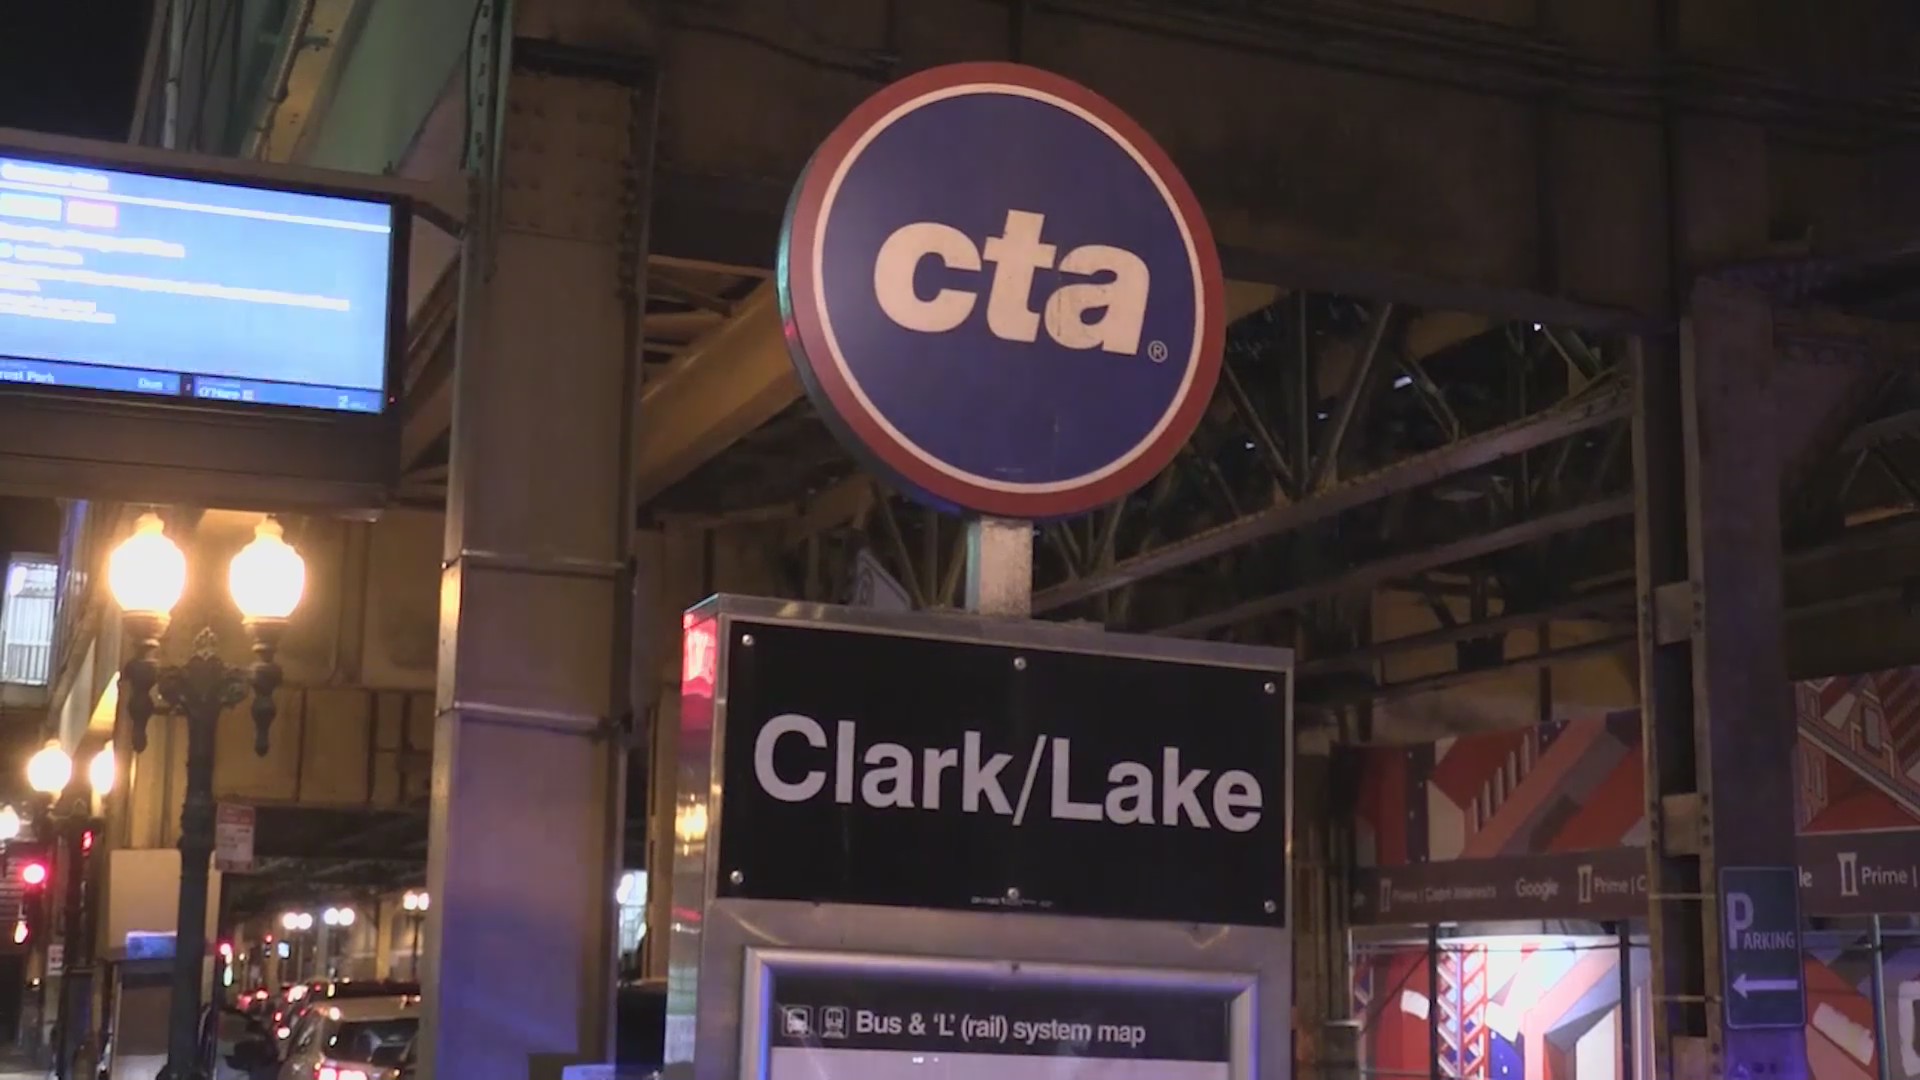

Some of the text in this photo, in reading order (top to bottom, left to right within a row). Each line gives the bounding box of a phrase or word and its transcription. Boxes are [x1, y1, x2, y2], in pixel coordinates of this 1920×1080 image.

[874, 208, 1152, 356] cta
[753, 712, 1263, 833] Clark/Lake
[1594, 876, 1629, 894] Prime
[1861, 865, 1908, 885] Prime
[856, 1009, 902, 1034] Bus
[908, 1012, 926, 1035] &
[961, 1015, 1008, 1043] (rail)
[1013, 1018, 1092, 1047] system
[1097, 1023, 1146, 1048] map
